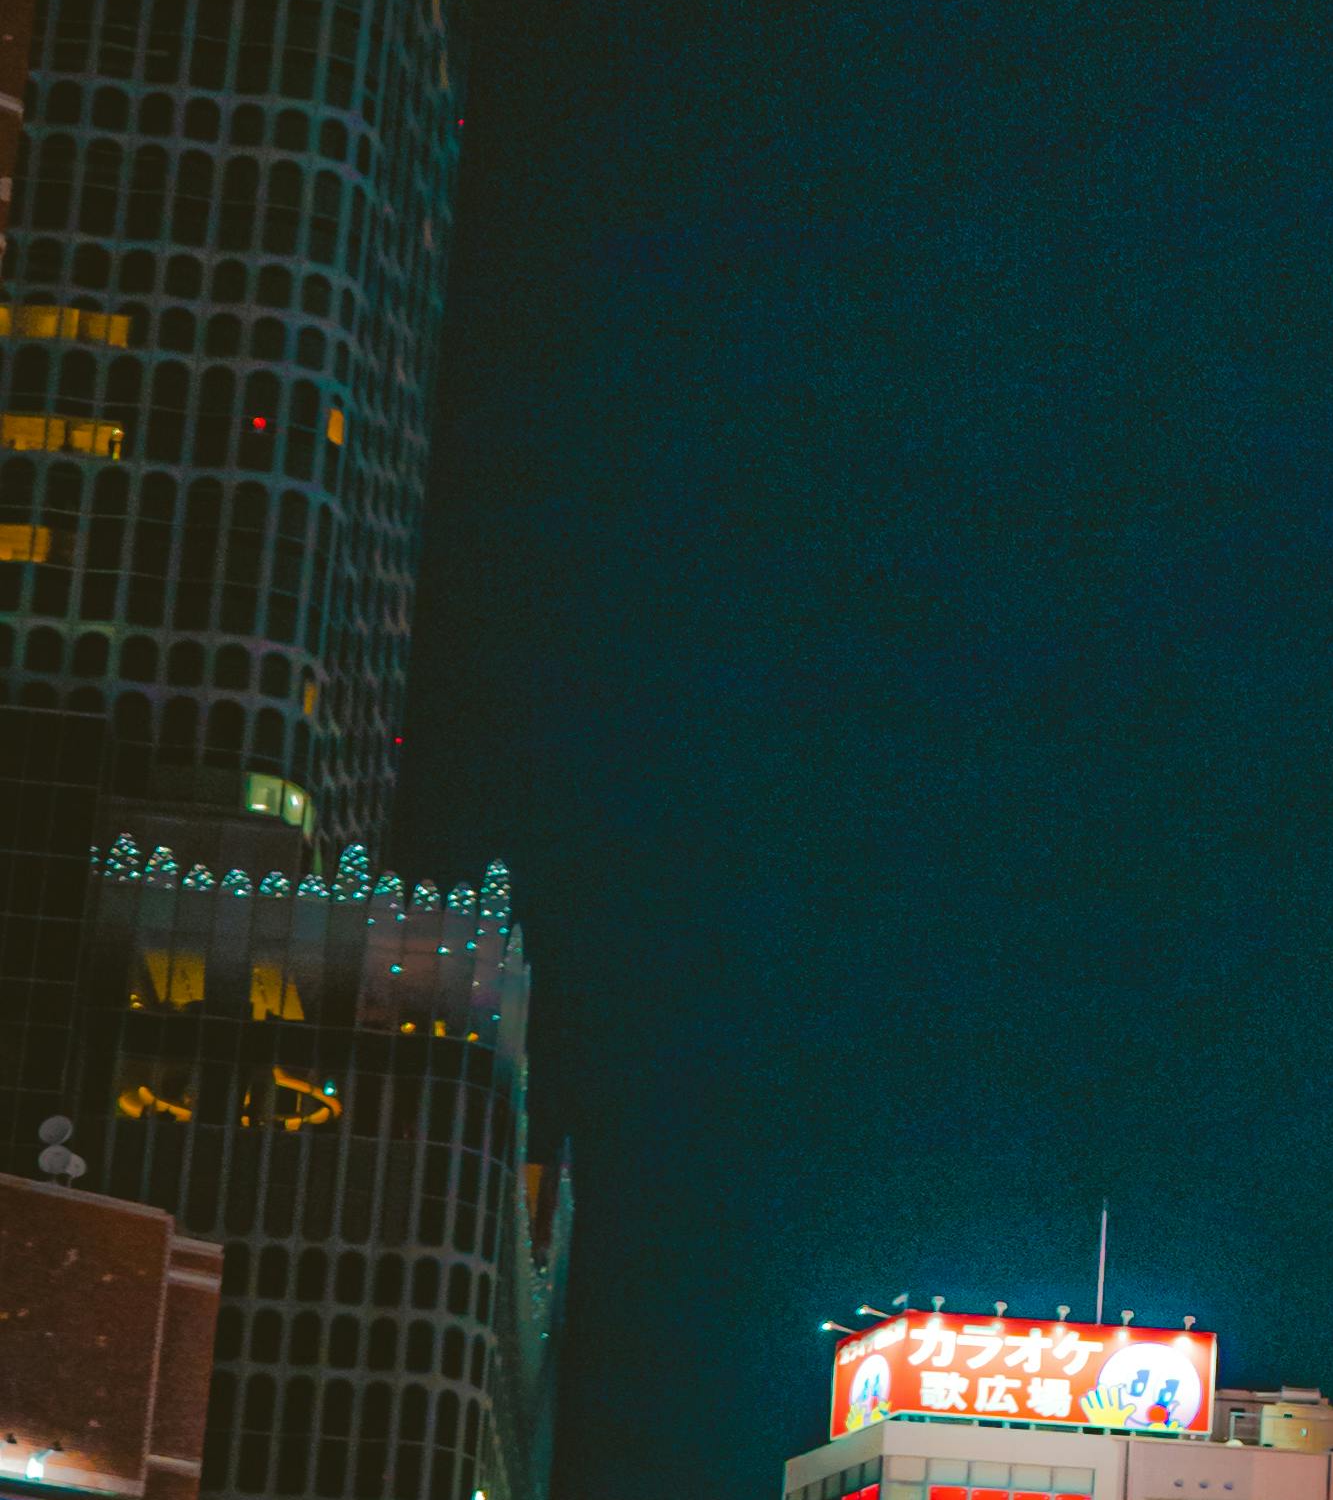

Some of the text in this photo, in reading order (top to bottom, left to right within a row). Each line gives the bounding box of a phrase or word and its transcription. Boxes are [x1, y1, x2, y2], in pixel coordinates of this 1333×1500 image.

[908, 1316, 1103, 1376] カラオケ
[919, 1370, 1073, 1418] 歌広場
